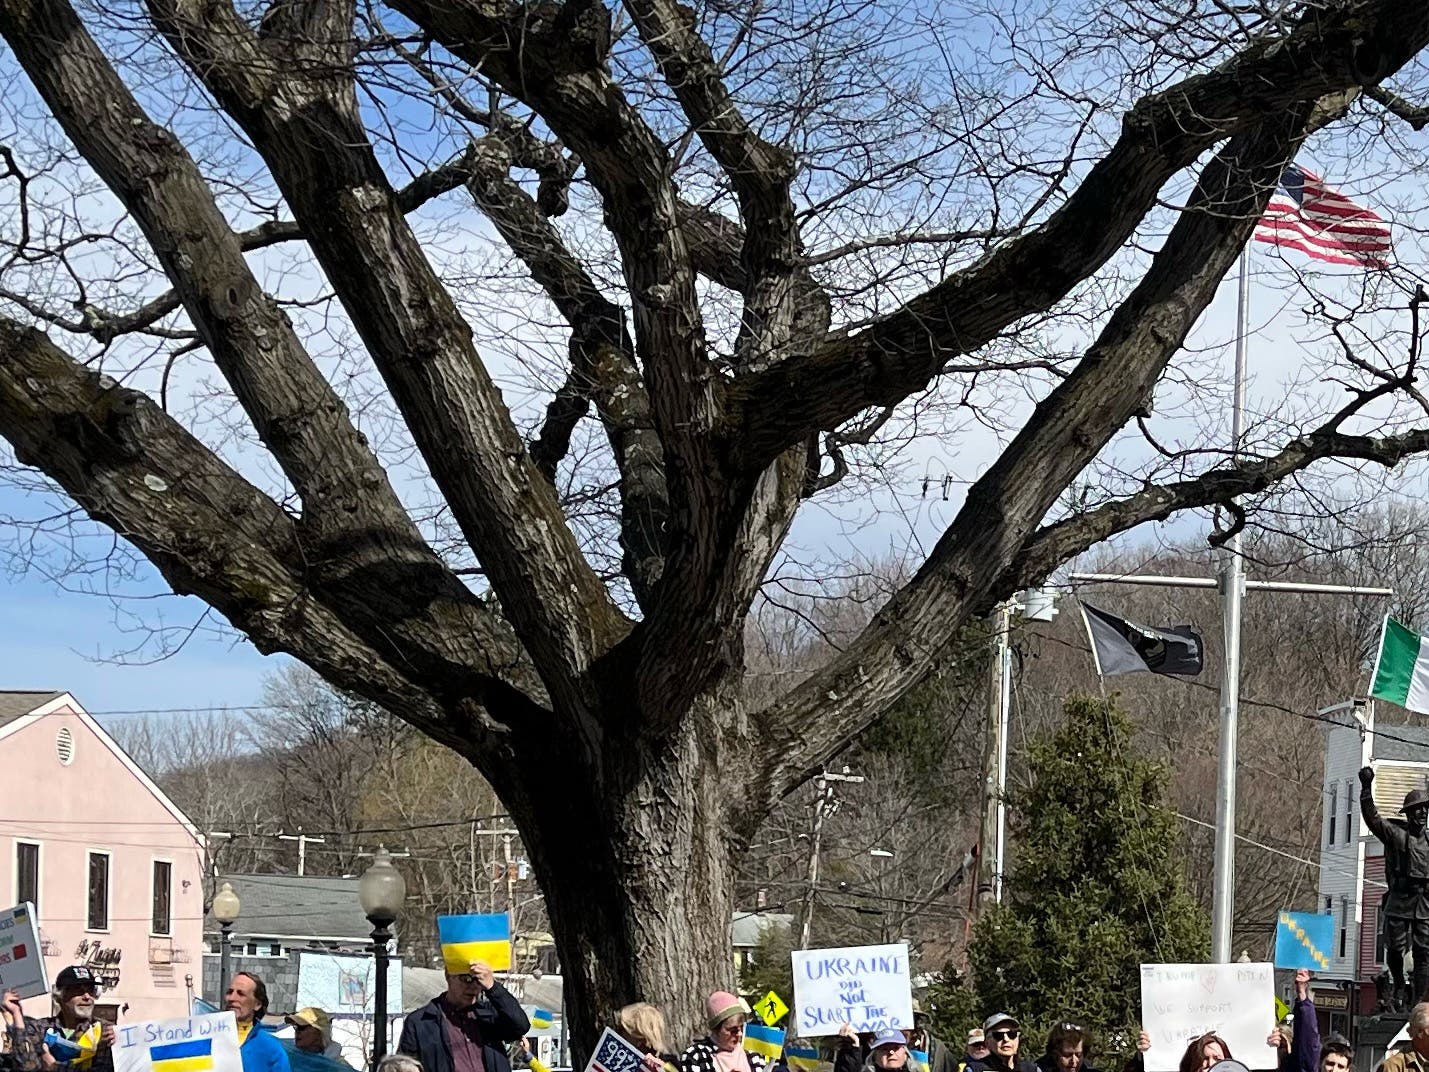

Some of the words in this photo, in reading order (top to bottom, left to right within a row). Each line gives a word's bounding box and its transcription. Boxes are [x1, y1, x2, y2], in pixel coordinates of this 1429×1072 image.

[806, 955, 905, 980] UKRAINE
[863, 1005, 888, 1020] THE
[120, 1026, 138, 1049] I
[144, 1020, 192, 1043] Stand
